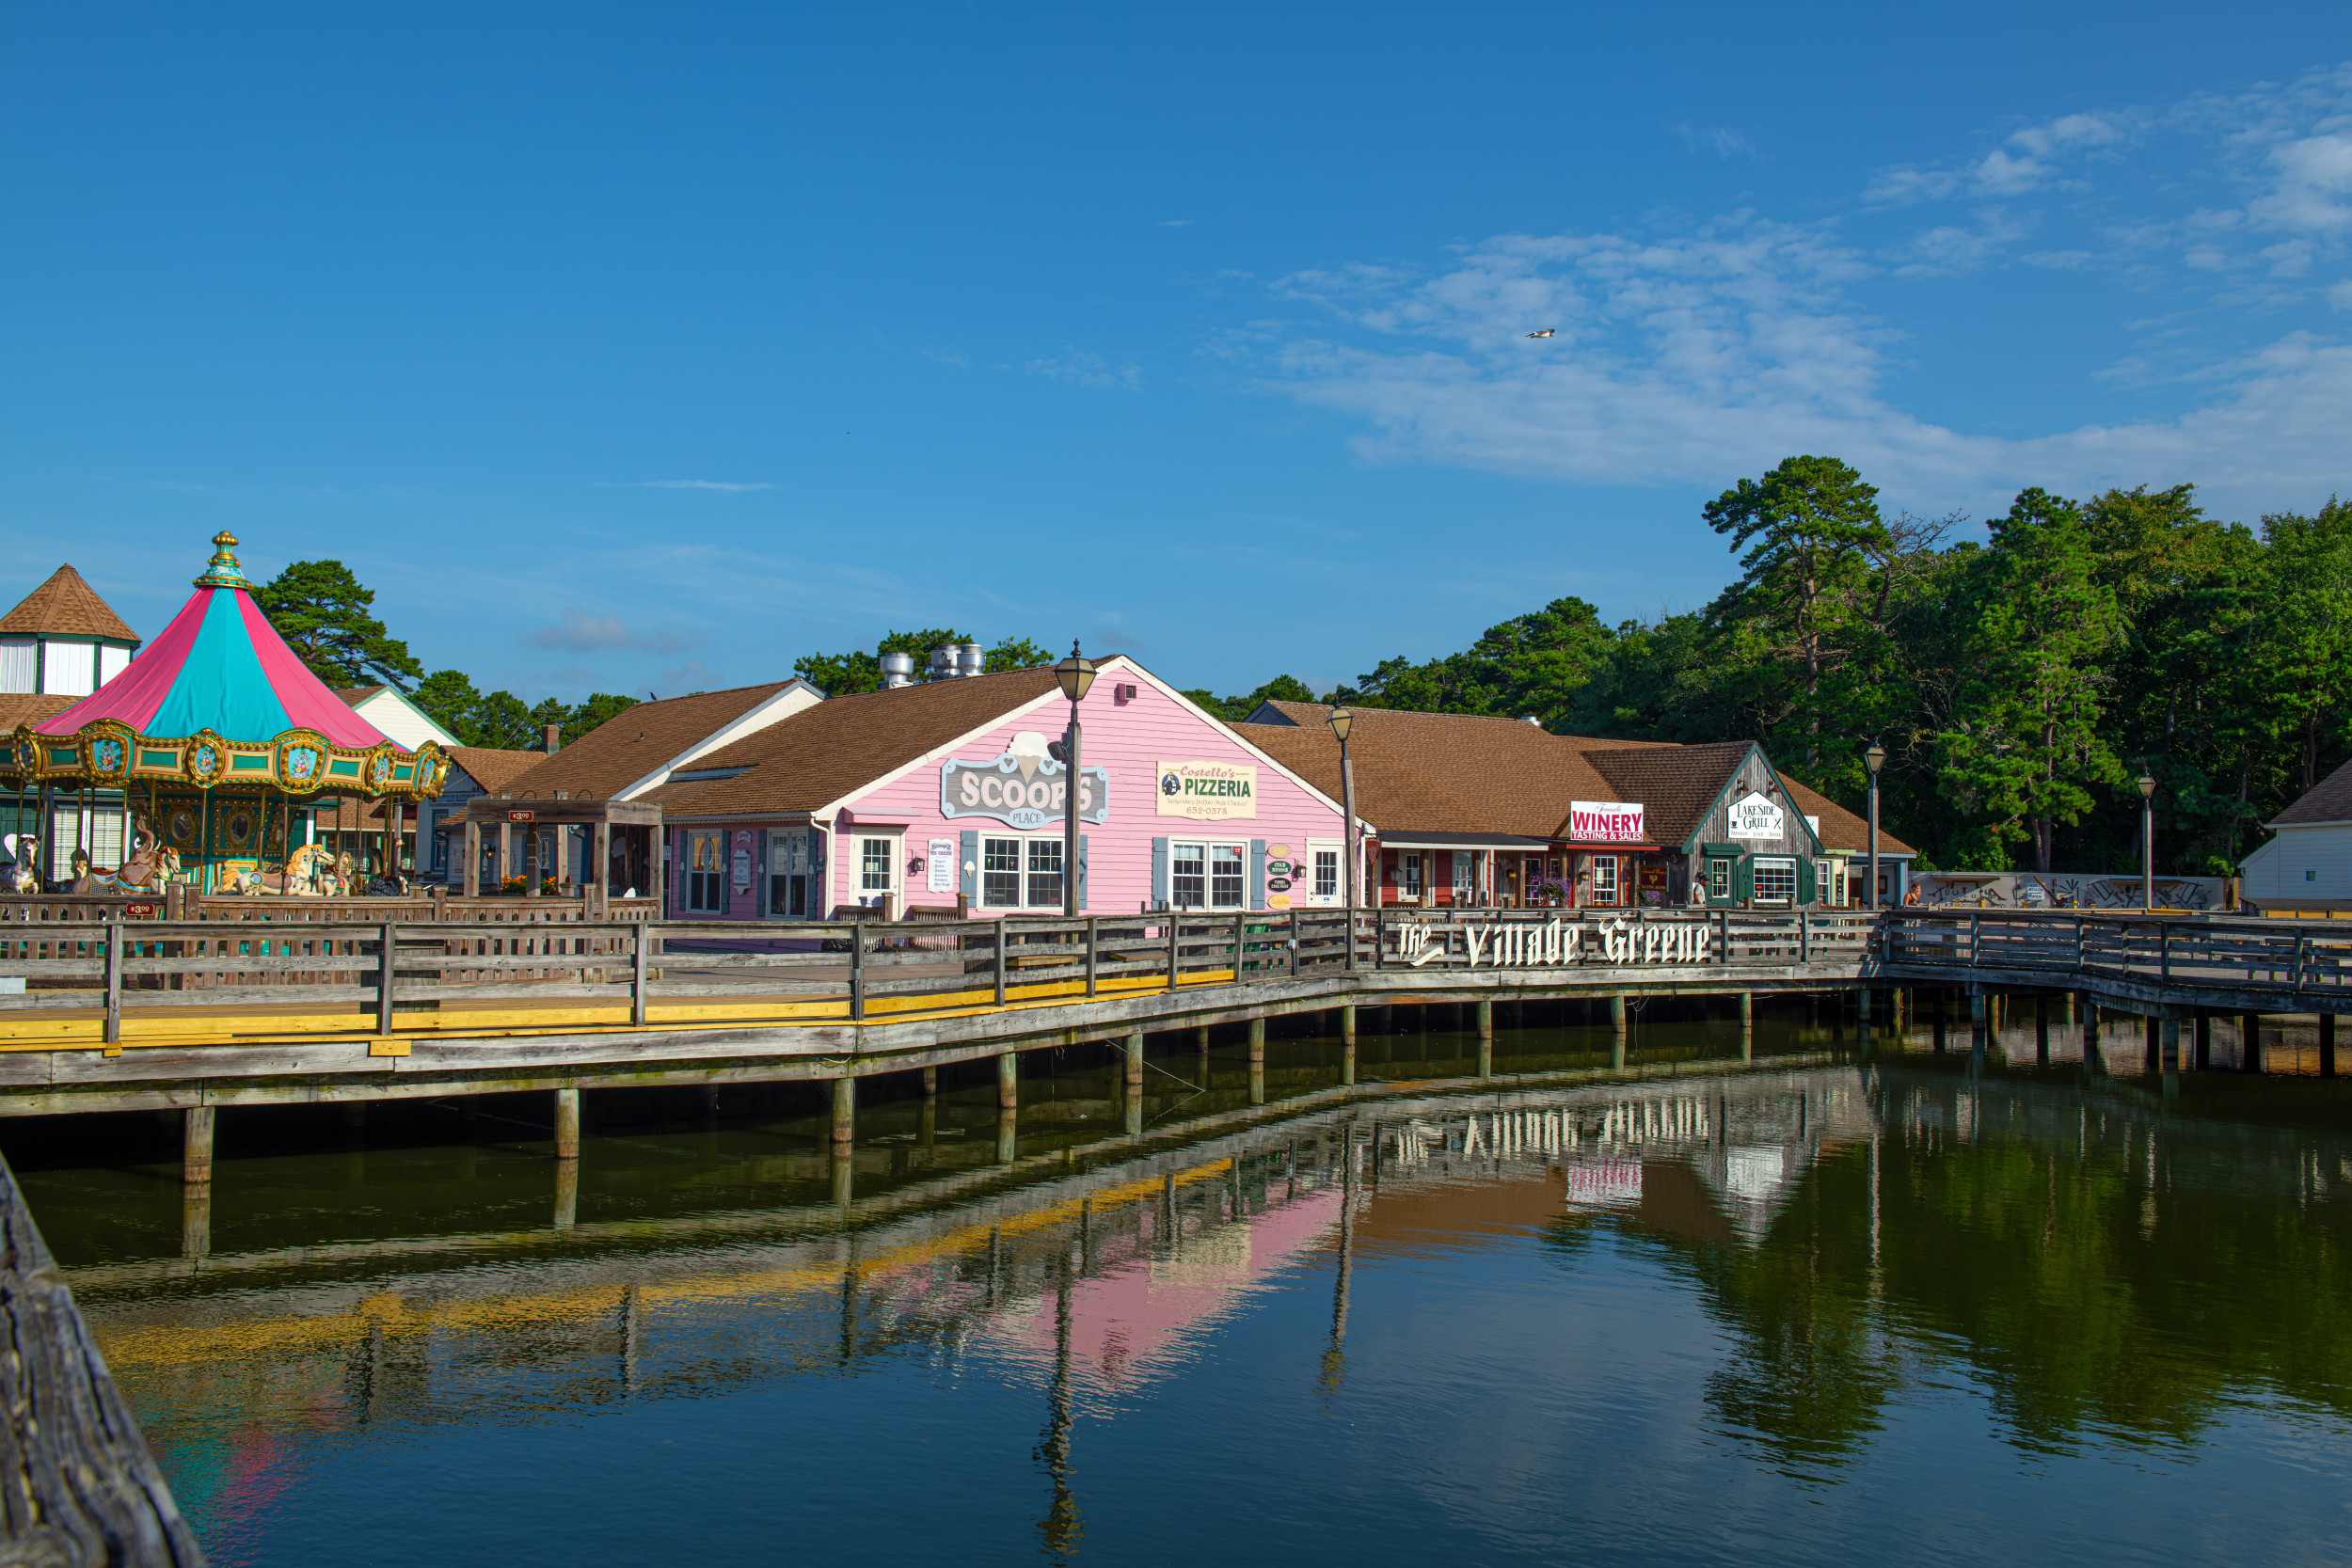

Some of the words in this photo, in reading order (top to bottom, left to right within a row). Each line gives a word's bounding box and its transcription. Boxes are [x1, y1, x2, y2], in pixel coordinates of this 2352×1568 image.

[1180, 766, 1235, 778] Costello's
[1184, 778, 1251, 798] PIZZERIA
[1185, 806, 1228, 816] 652-0378
[1012, 813, 1042, 824] PLACE
[1572, 810, 1643, 832] WINERY
[1742, 816, 1769, 830] GRILL
[1573, 831, 1608, 839] TASTING
[1610, 832, 1616, 840] &
[1397, 923, 1443, 966] The
[1464, 917, 1581, 968] Village
[1597, 917, 1711, 966] Greene
